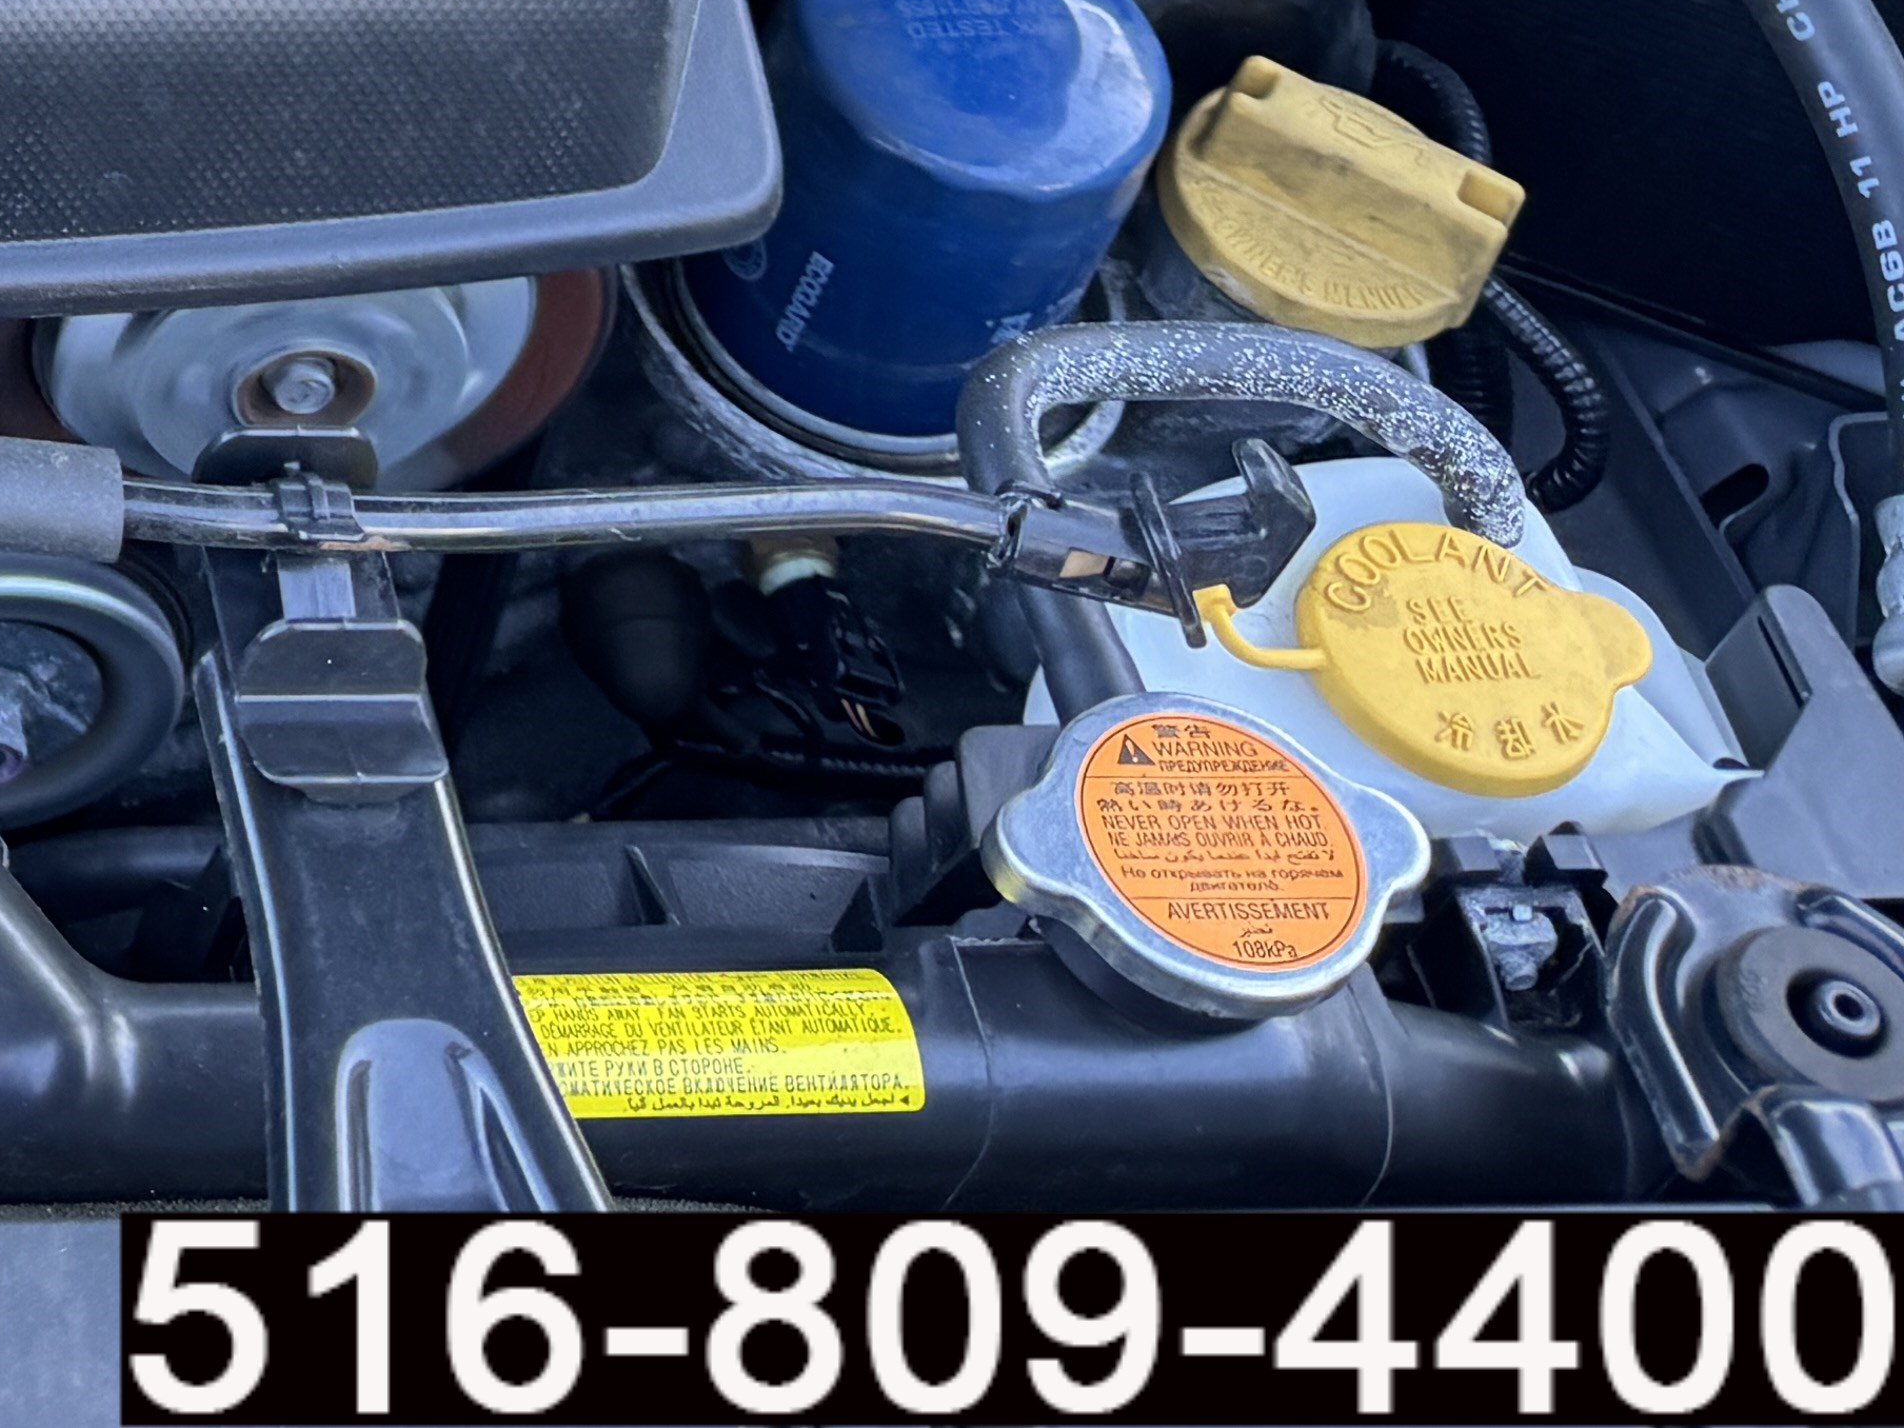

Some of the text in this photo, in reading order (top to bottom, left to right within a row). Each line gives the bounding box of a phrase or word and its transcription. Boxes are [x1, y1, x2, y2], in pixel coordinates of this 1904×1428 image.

[1817, 80, 1859, 139] HP
[1322, 528, 1550, 615] COOLANT
[1405, 595, 1471, 626] SEE
[1401, 621, 1524, 656] OWNERS
[1413, 651, 1542, 685] MANUAL
[1152, 740, 1259, 758] WARNING
[1100, 814, 1161, 832] NEVER
[1168, 814, 1216, 831] OPEN
[1221, 814, 1280, 831] WHEN
[1108, 831, 1131, 847] NE
[1134, 831, 1191, 847] JAMAIS
[1194, 831, 1253, 848] OUVRIR
[1167, 901, 1331, 922] AVERTISSEMENT
[1231, 939, 1298, 960] 108kPa
[657, 1005, 686, 1021] FAN
[691, 1004, 746, 1021] STARTS
[624, 1021, 643, 1038] DU
[649, 1020, 743, 1037] VENTILATEUR
[567, 1039, 651, 1058] APPROCHEZ
[657, 1039, 687, 1056] PAS
[694, 1038, 724, 1056] LES
[550, 1059, 599, 1078] ЖИТЕ
[604, 1059, 649, 1078] РУКИ
